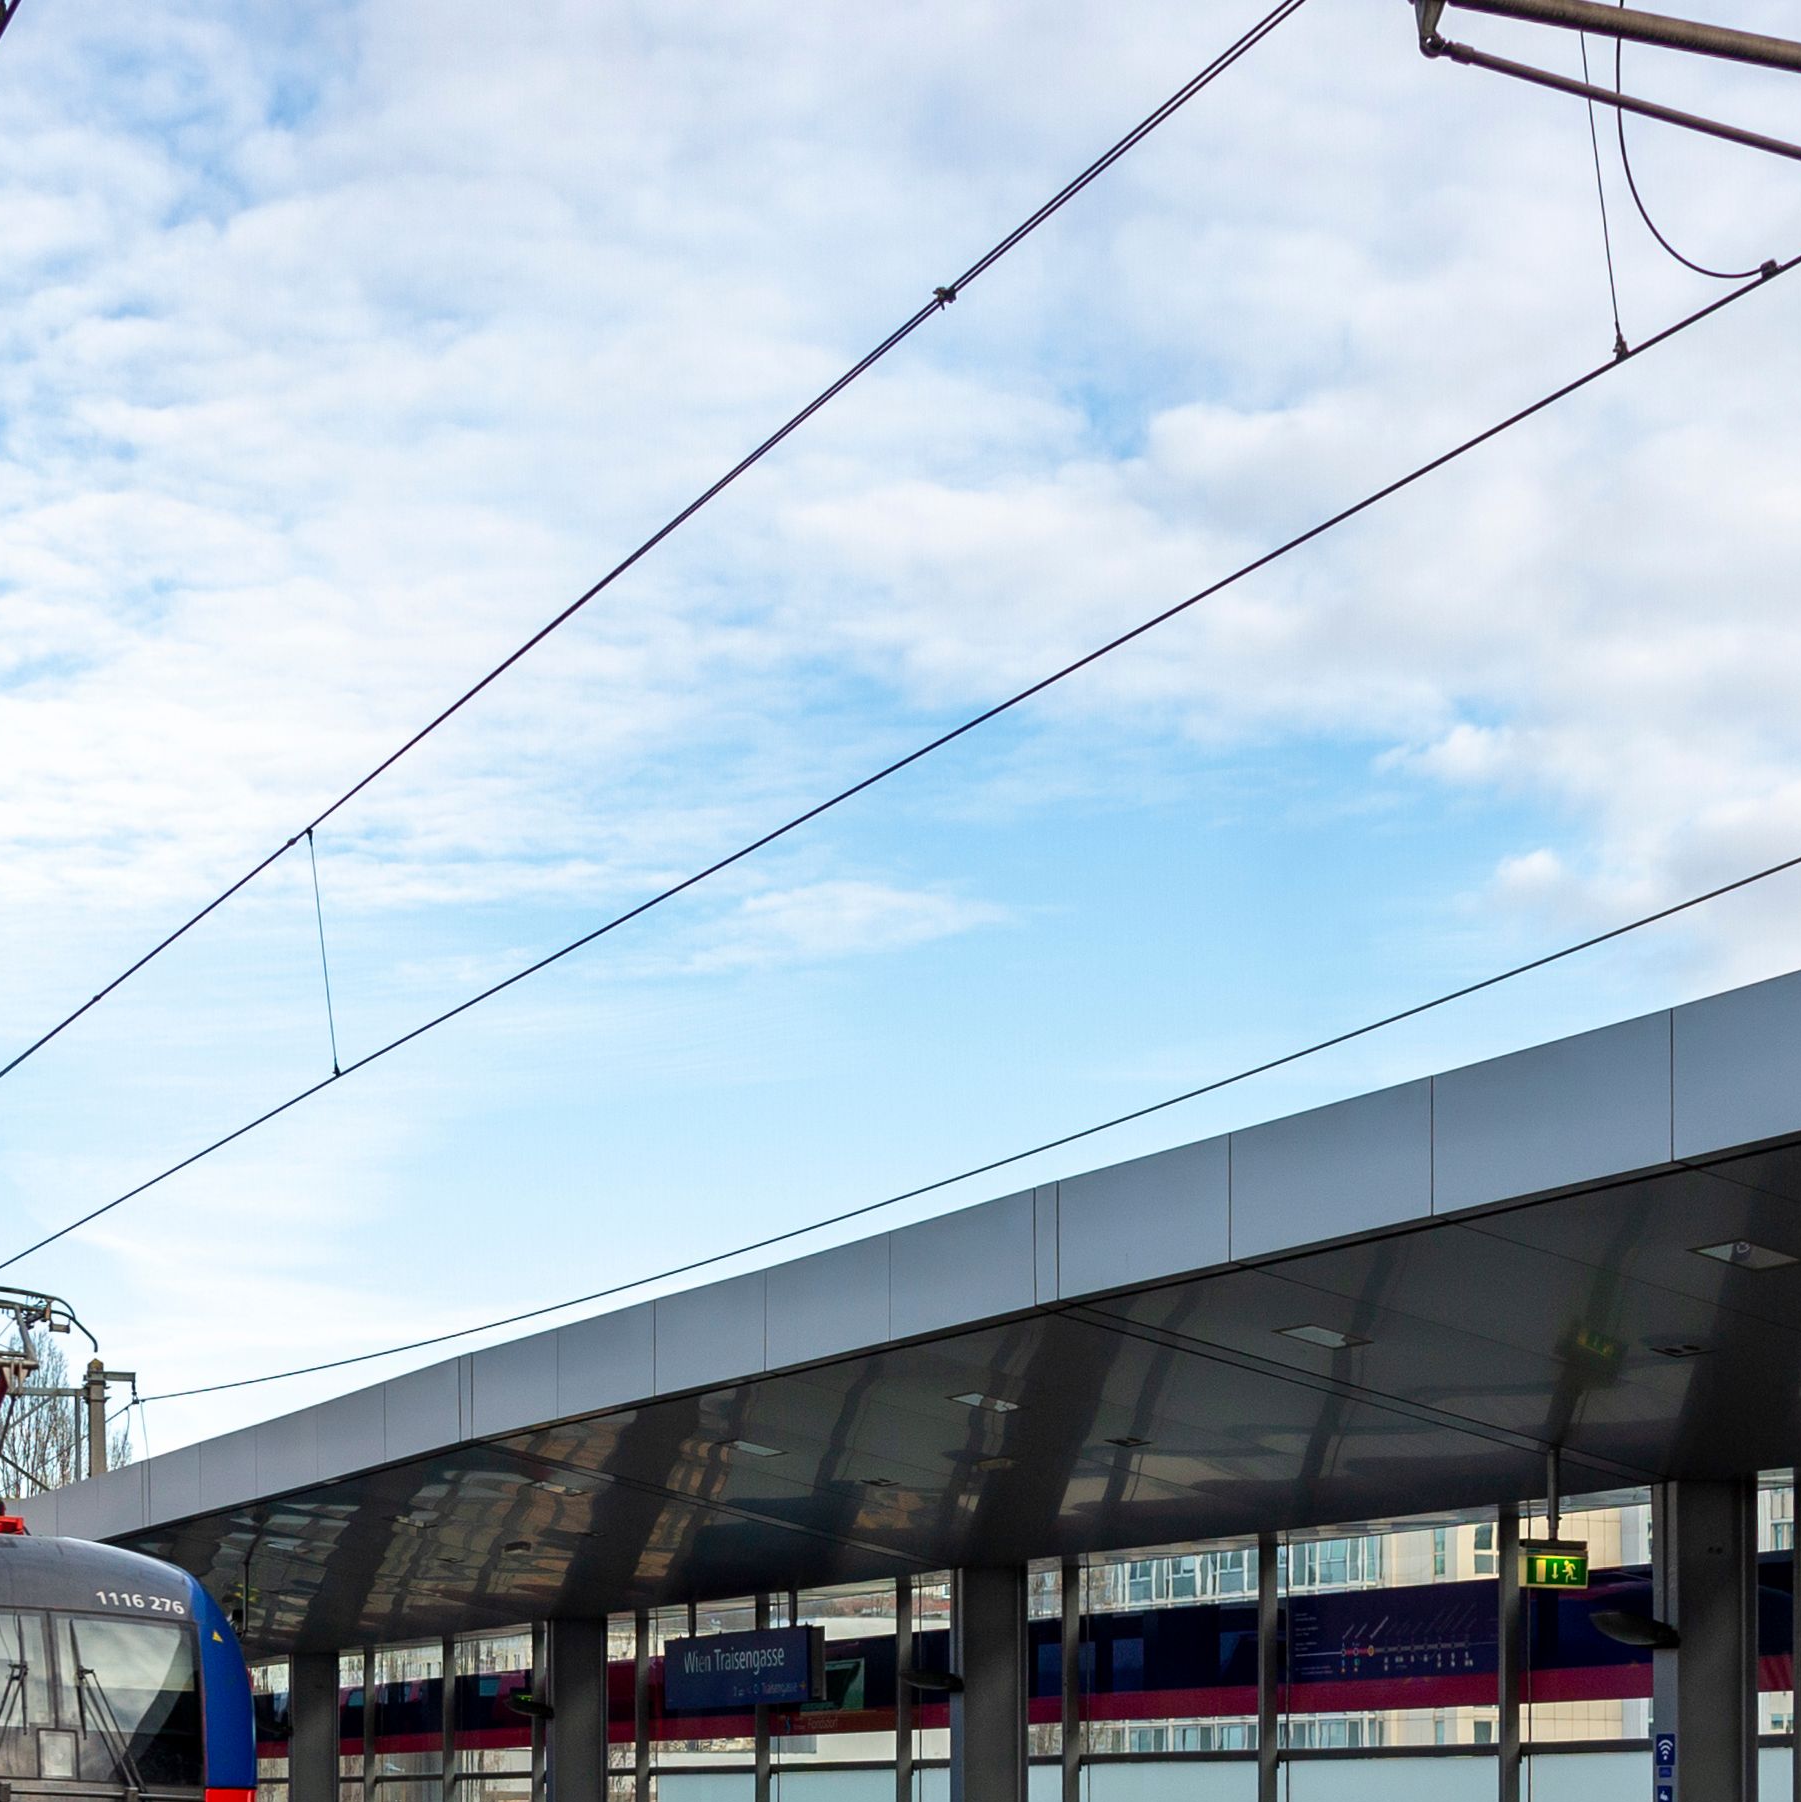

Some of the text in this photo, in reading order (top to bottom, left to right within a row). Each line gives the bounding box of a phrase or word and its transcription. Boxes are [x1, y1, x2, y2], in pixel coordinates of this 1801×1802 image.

[95, 1591, 185, 1614] 1116 276
[684, 1647, 785, 1676] Wien Traisengasse
